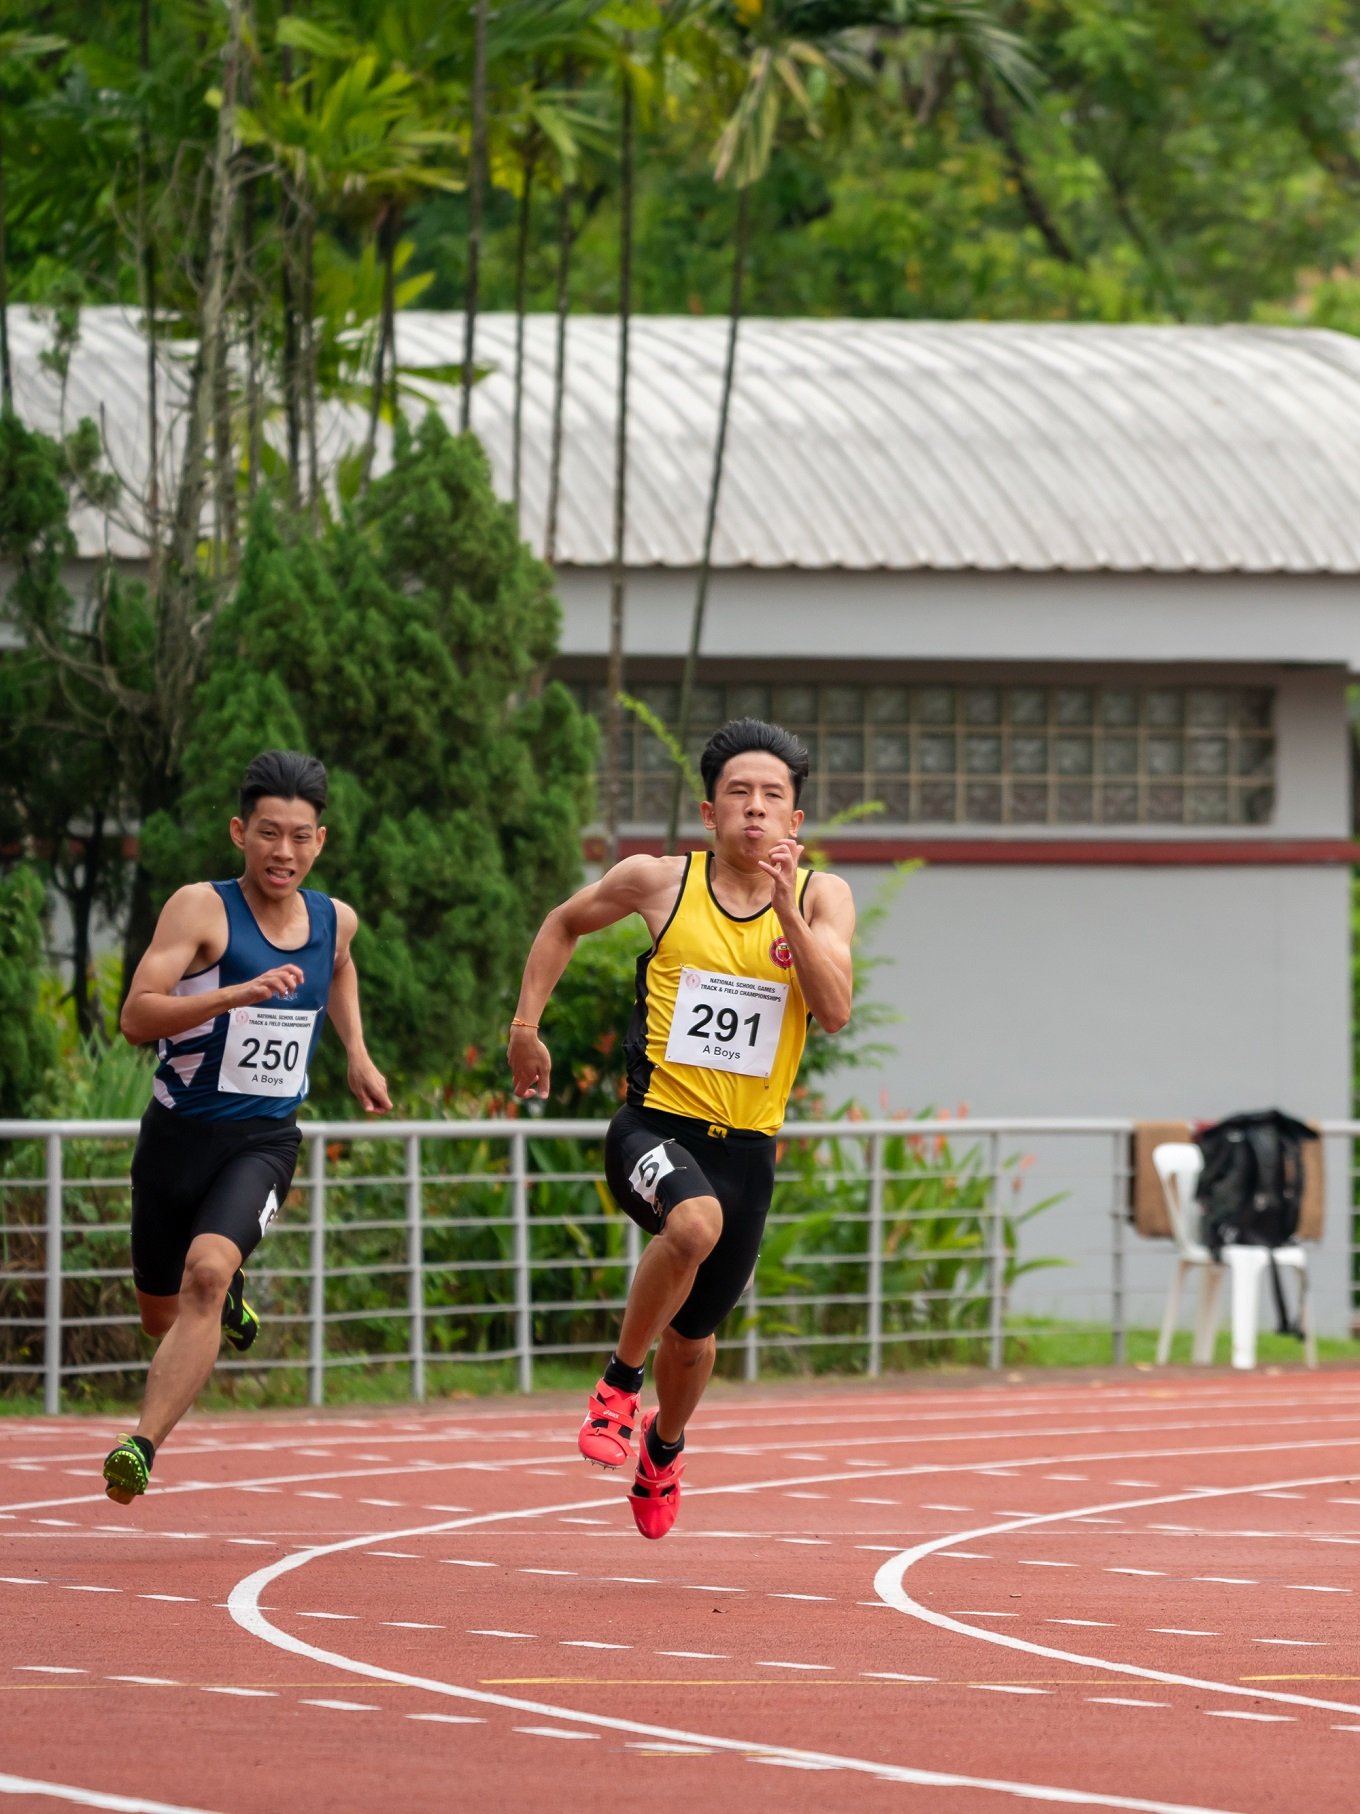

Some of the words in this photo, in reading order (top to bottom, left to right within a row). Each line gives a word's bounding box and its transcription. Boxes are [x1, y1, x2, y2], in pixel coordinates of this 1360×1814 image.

[700, 983, 718, 992] TRACK
[739, 990, 782, 1003] CHAMPIONSHIPS
[709, 977, 735, 987] NATIONAL
[735, 981, 756, 990] SCHOOL
[757, 985, 776, 994] GAMES
[686, 1003, 761, 1047] 291
[237, 1037, 299, 1072] 250
[702, 1044, 711, 1054] A
[713, 1046, 741, 1060] Boys
[251, 1074, 258, 1082] A
[261, 1074, 284, 1086] Boys
[638, 1153, 660, 1188] 5
